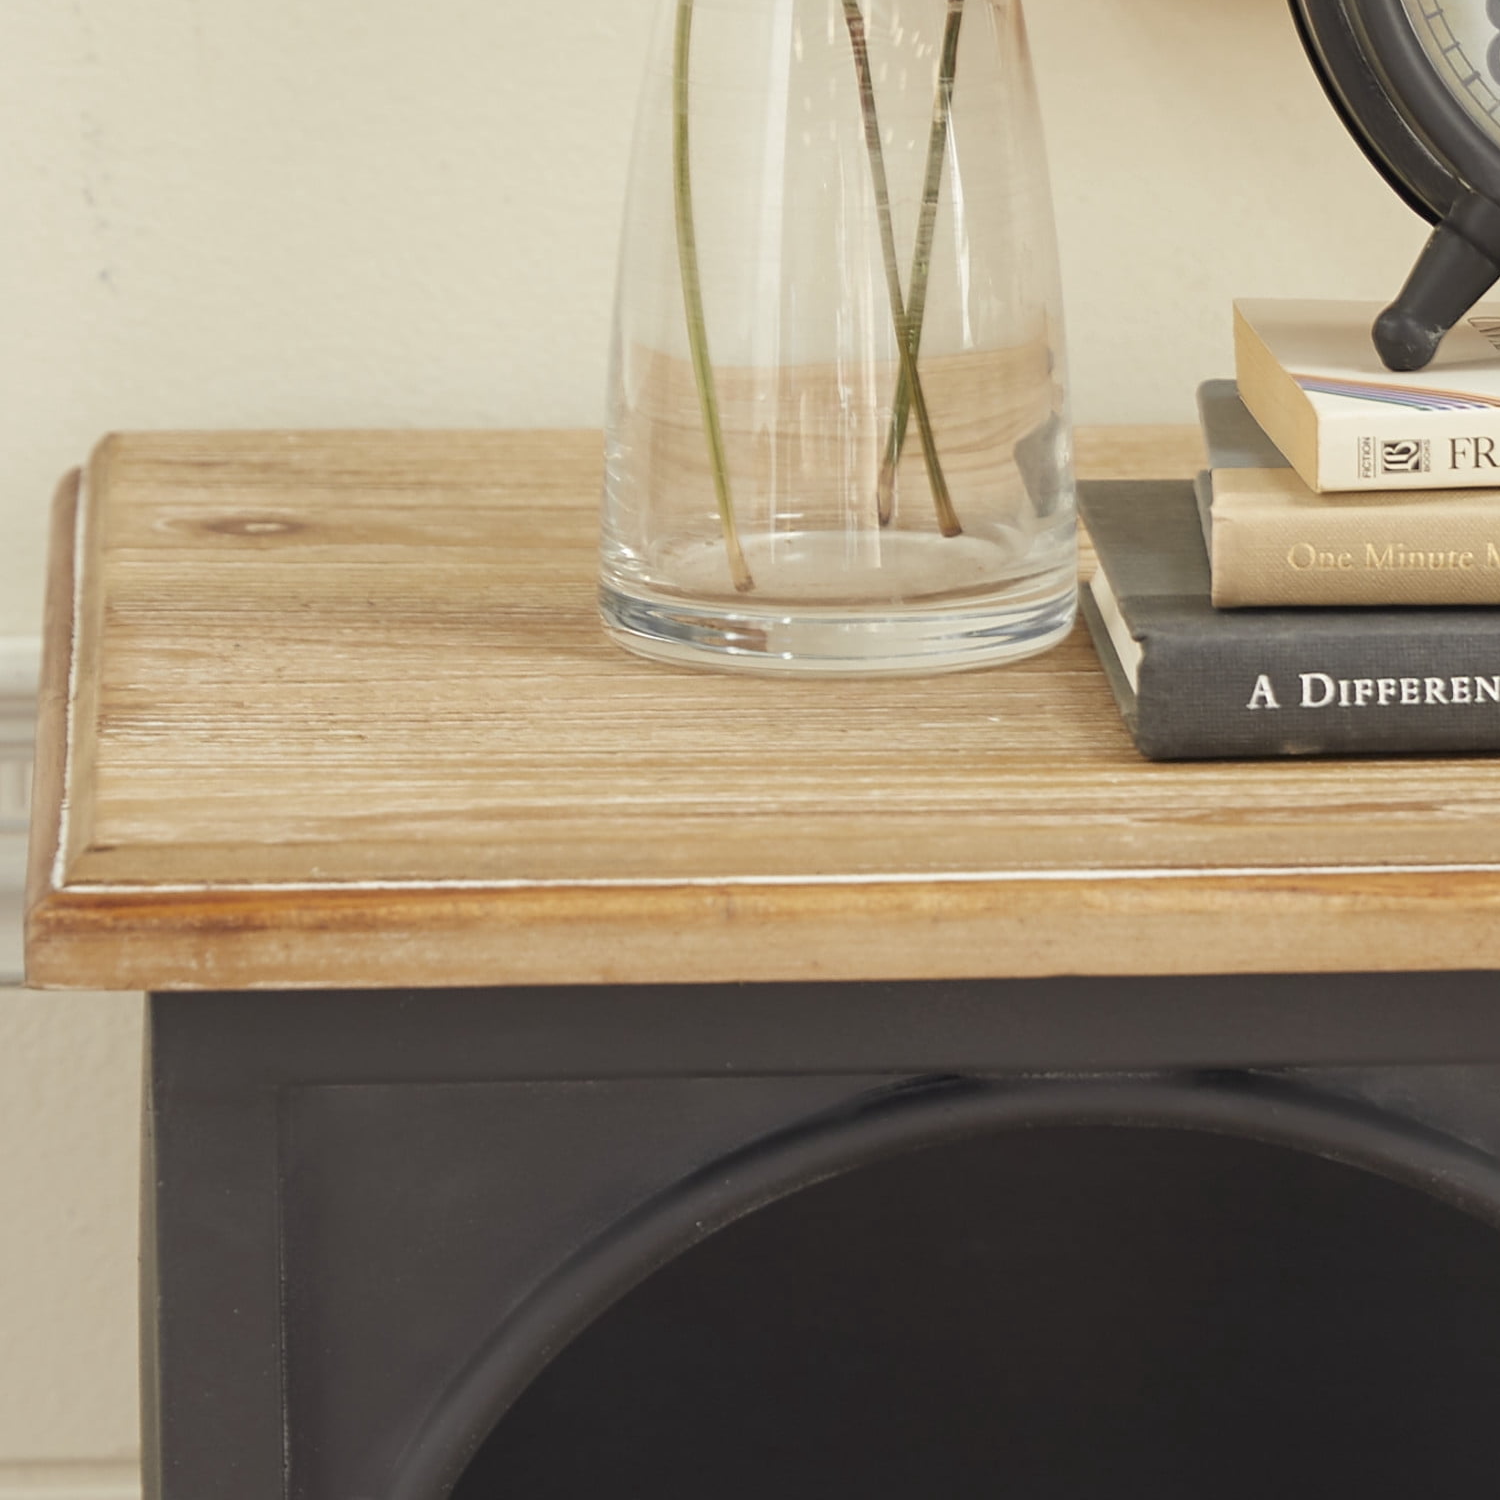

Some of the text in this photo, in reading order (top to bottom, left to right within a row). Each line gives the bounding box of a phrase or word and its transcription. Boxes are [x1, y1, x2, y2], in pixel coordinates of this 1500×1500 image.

[1361, 436, 1371, 478] FICTION
[1287, 542, 1352, 571] One
[1365, 541, 1473, 570] Minute
[1246, 675, 1280, 710] A
